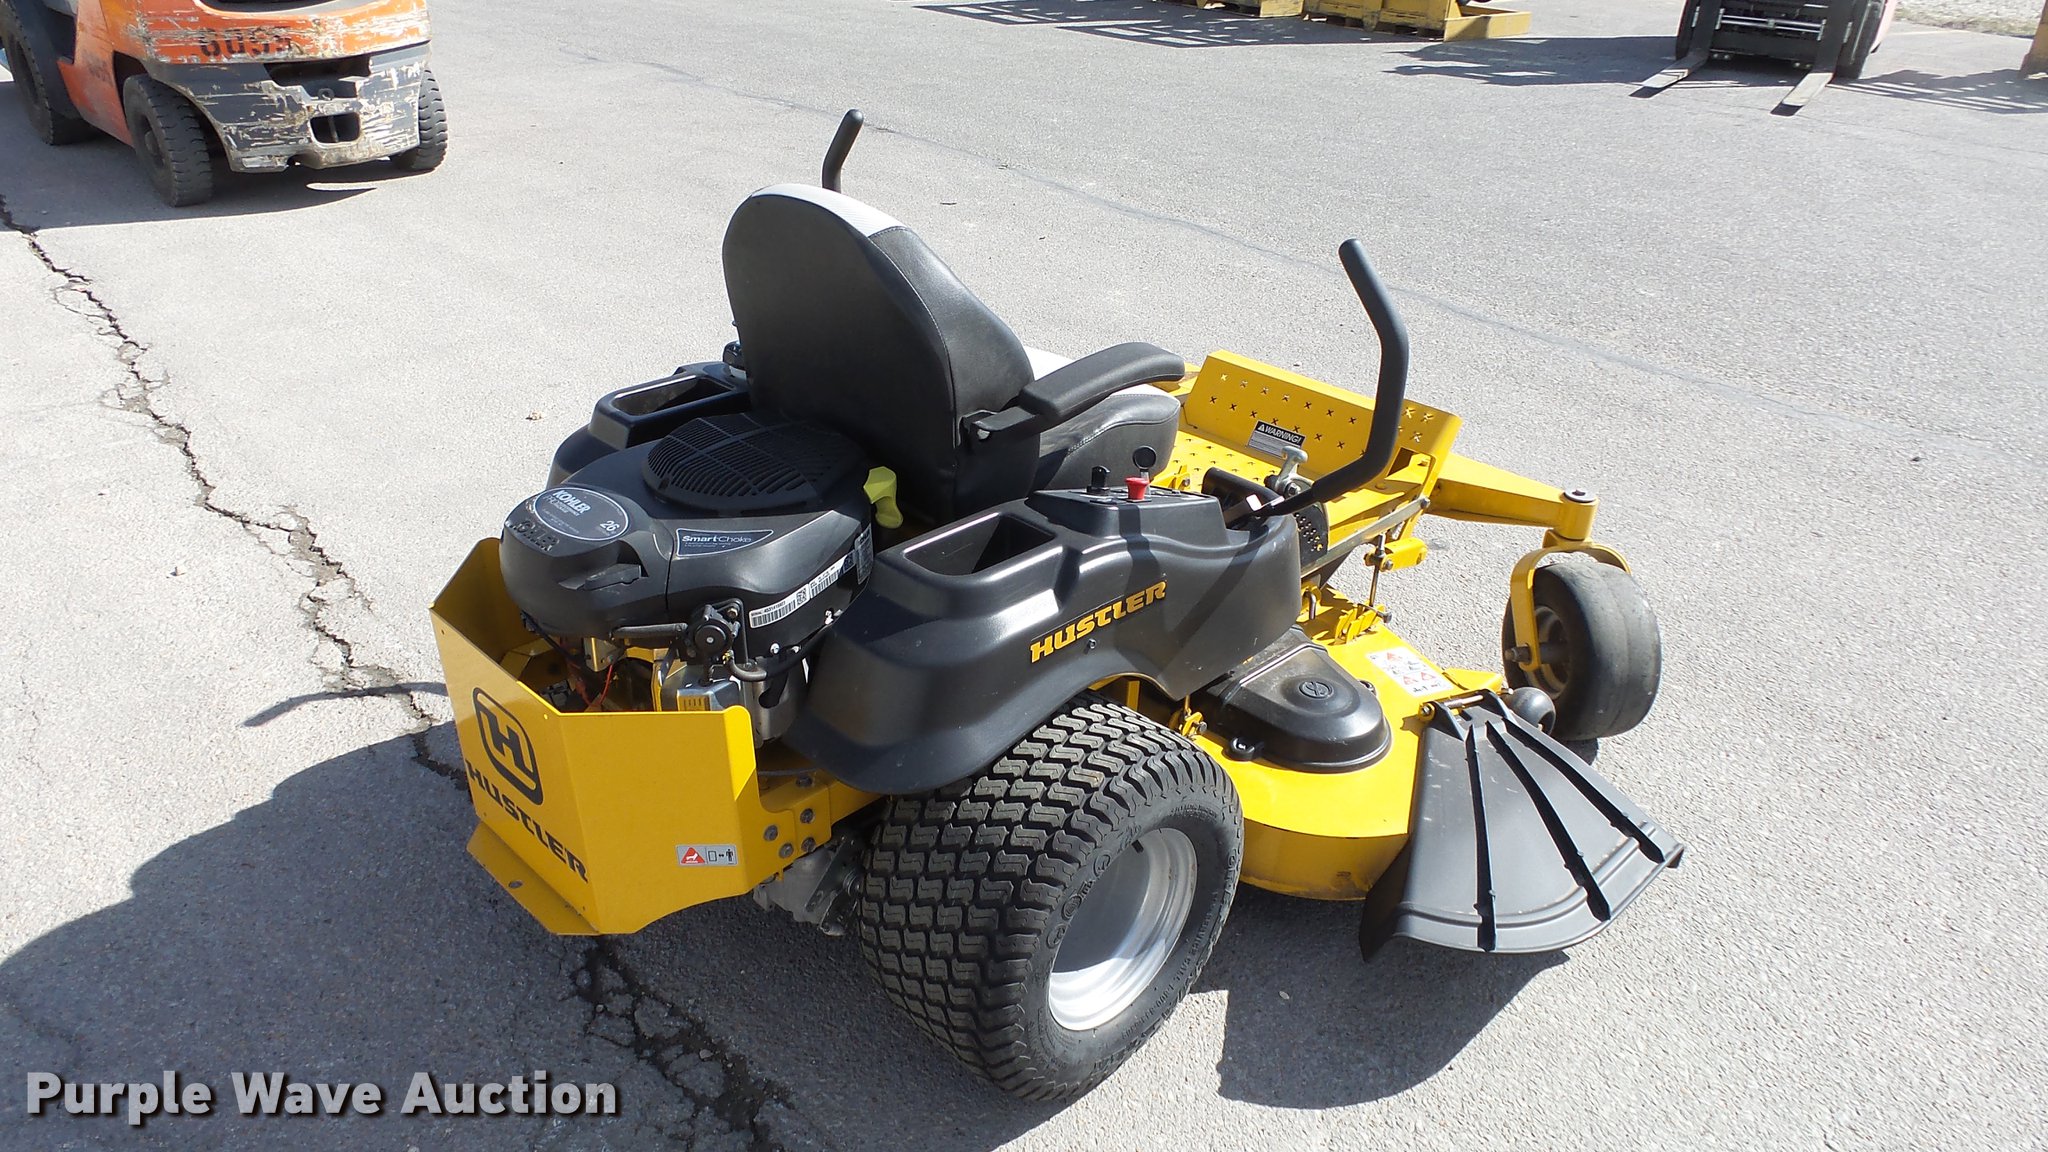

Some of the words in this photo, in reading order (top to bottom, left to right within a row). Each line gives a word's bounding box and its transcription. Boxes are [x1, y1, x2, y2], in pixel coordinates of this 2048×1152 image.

[1264, 425, 1302, 443] WARNING!
[552, 489, 592, 514] KOHLER
[600, 520, 620, 532] 26
[1030, 580, 1167, 663] HUSTLER
[465, 759, 588, 883] HUSTLER
